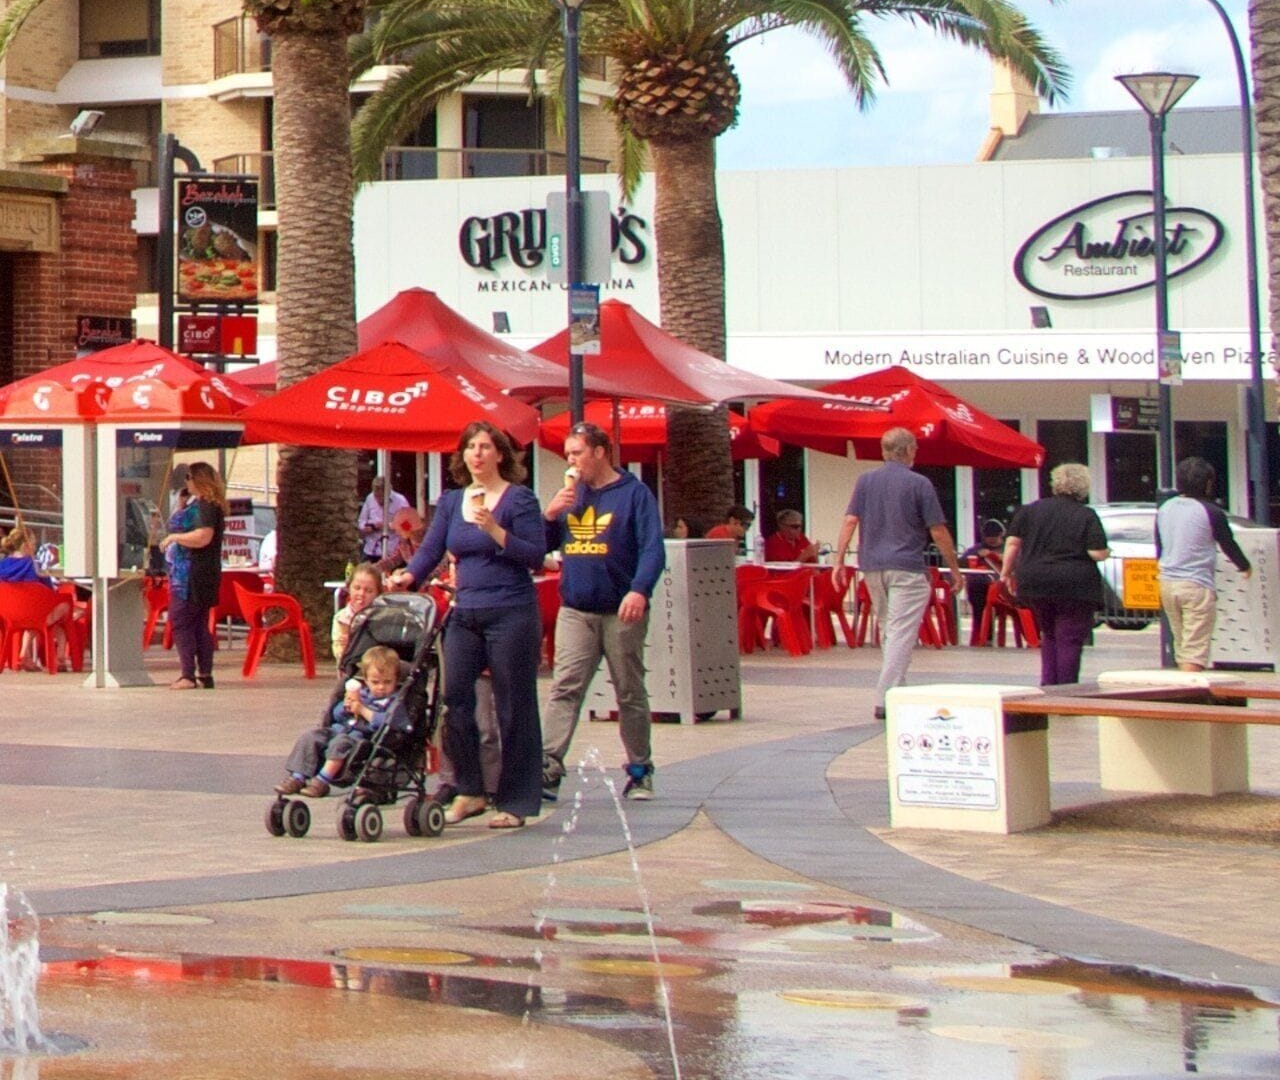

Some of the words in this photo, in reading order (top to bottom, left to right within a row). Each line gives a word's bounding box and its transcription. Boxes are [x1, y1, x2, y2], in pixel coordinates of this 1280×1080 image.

[1038, 222, 1196, 262] Ambiet
[1064, 264, 1138, 276] Restaurant
[477, 280, 552, 293] MEXICAN
[183, 330, 210, 340] CIBO
[825, 349, 892, 366] Modern
[899, 349, 990, 365] Australian
[997, 348, 1069, 365] Cuisine
[1077, 348, 1090, 365] &
[1097, 348, 1155, 365] Wood
[1179, 352, 1215, 364] ven
[326, 386, 412, 406] CIBO
[565, 541, 609, 555] adidas
[664, 567, 674, 655] HOLDFAST
[669, 668, 677, 699] BAY
